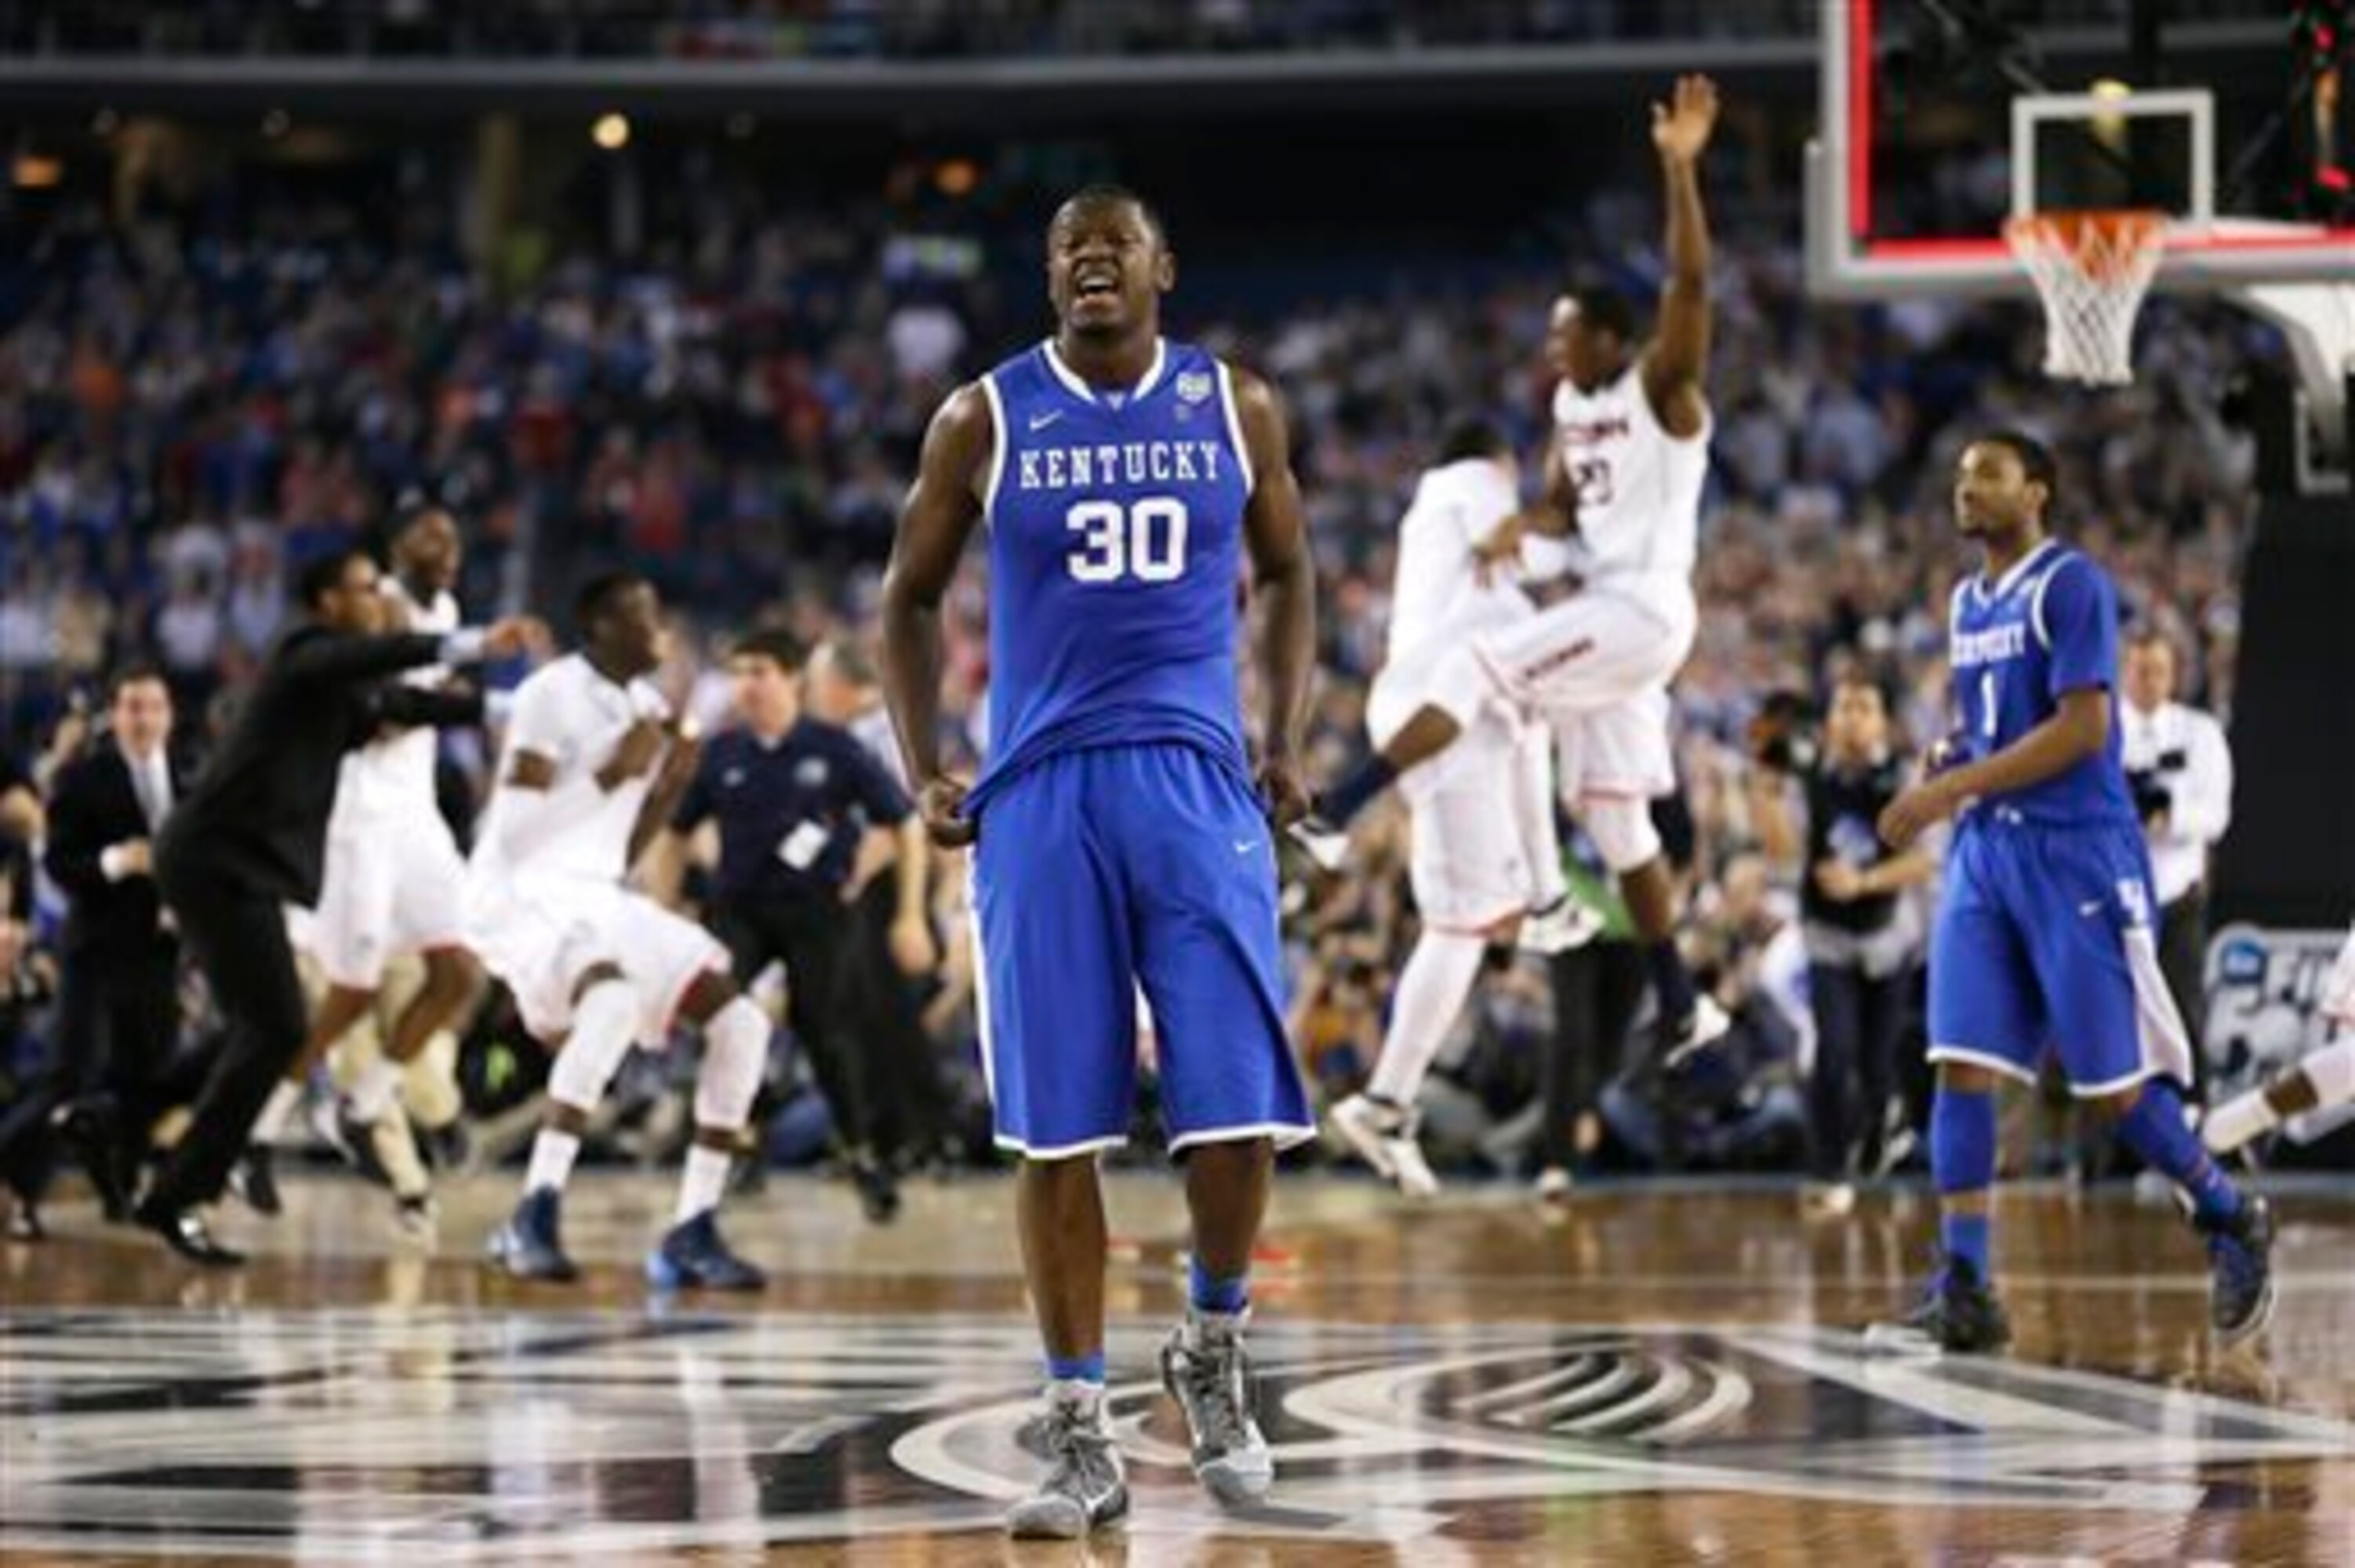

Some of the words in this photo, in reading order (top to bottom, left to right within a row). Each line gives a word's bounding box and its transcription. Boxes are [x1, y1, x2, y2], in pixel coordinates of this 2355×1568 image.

[1019, 441, 1219, 489] KENTUCKY
[1066, 496, 1188, 583] 30
[1980, 671, 1997, 737] 1
